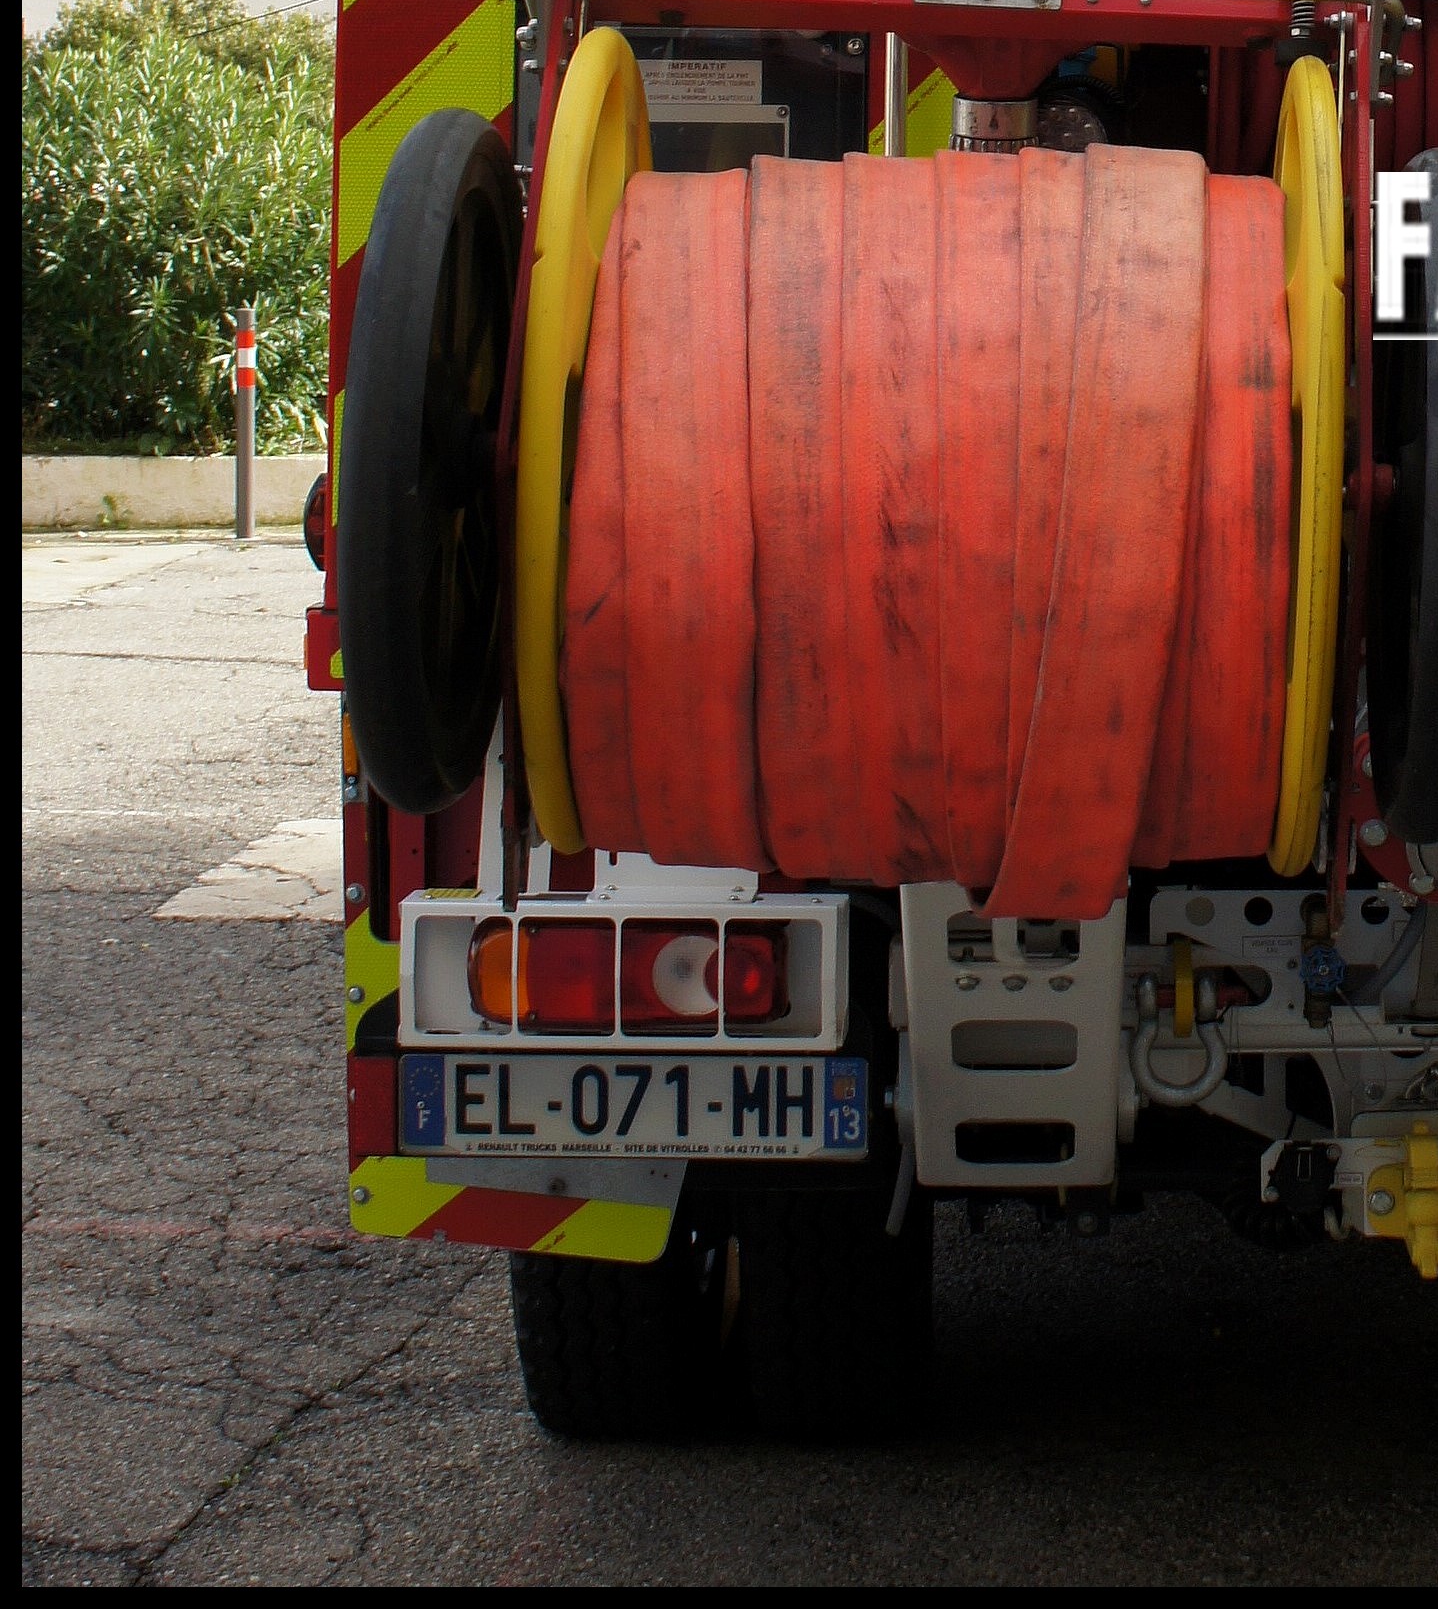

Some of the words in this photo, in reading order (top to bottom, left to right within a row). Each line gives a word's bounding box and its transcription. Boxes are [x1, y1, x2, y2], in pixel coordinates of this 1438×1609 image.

[668, 62, 727, 71] IMPERATIF
[456, 1063, 814, 1138] EL-071-MH
[417, 1109, 431, 1130] F
[829, 1107, 860, 1141] 13
[521, 1143, 557, 1152] TRUCKS
